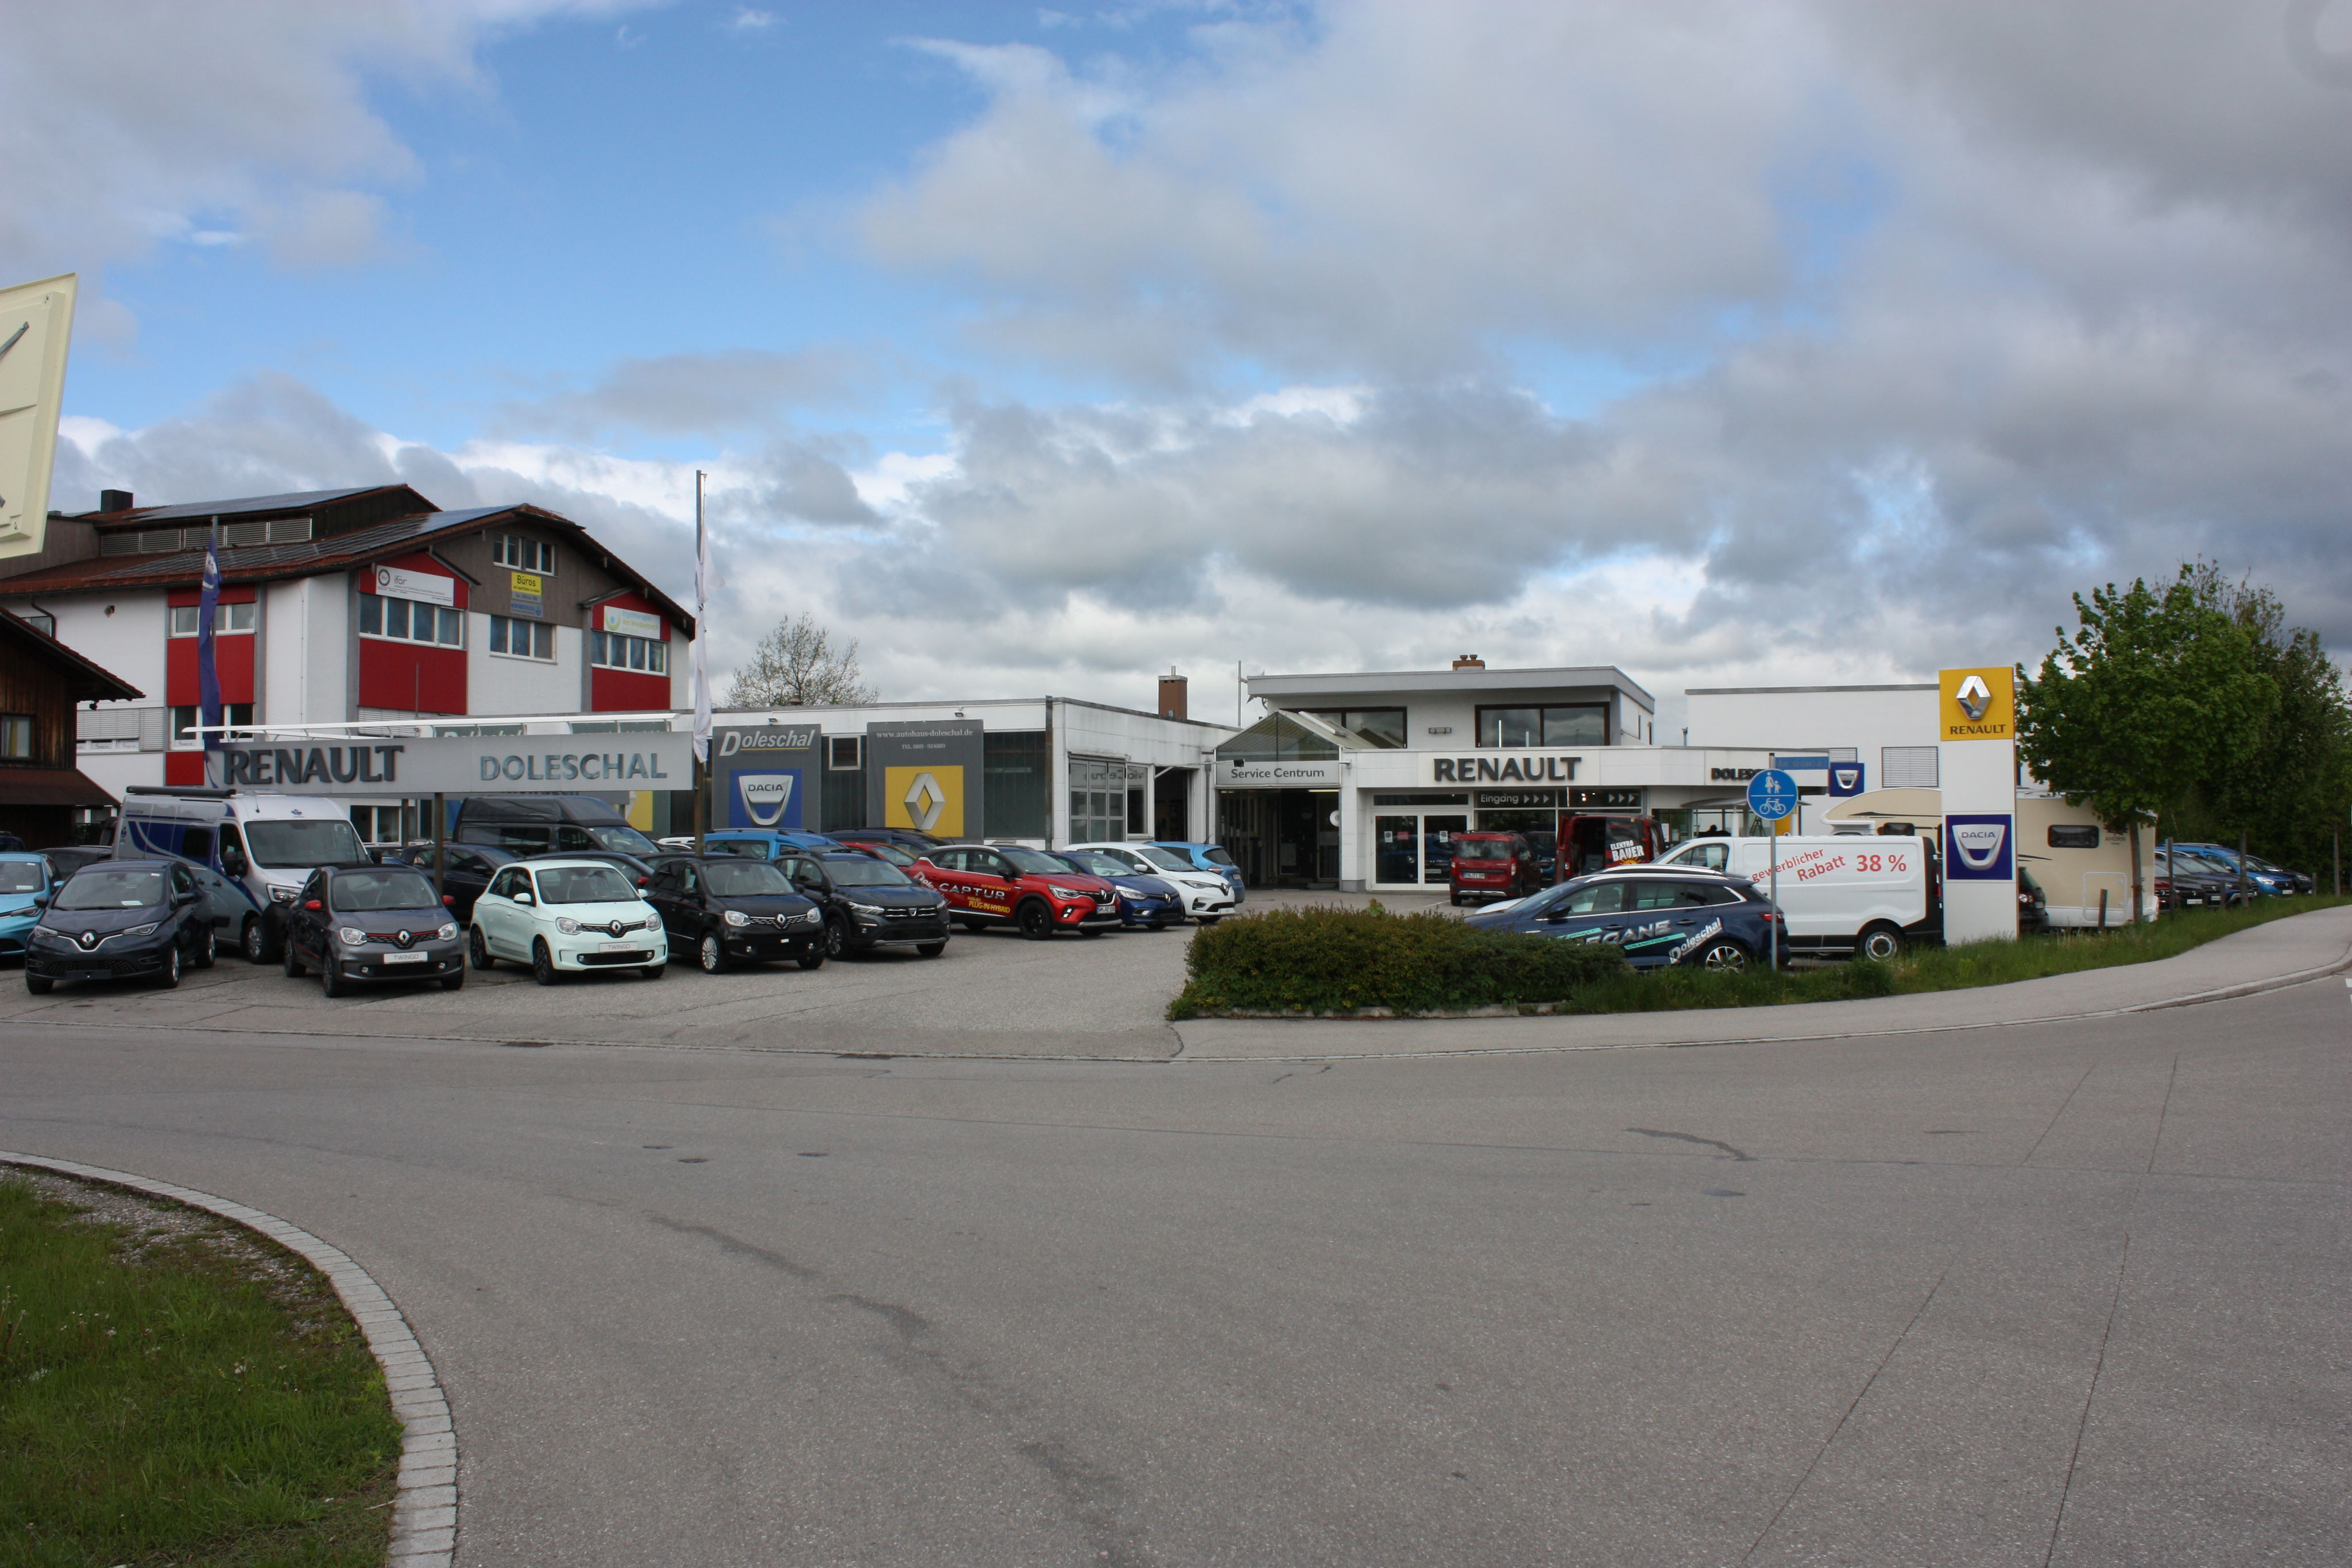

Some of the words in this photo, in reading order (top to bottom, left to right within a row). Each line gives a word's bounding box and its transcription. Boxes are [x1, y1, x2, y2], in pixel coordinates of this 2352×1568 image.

[394, 575, 407, 585] ifor
[517, 575, 536, 586] Büros
[876, 729, 973, 737] www.autohaus-doleschal.de
[1950, 725, 2006, 734] RENAULT
[719, 729, 815, 756] Doleschal
[223, 745, 404, 784] RENAULT
[480, 753, 668, 781] DOLESCHAL
[1434, 757, 1581, 781] RENAULT
[1231, 769, 1271, 778] Service
[1274, 768, 1324, 777] Centrum
[1481, 794, 1518, 803] Eingang
[1610, 840, 1634, 850] ELEKTRO
[1611, 845, 1645, 861] BAUER
[1752, 849, 1824, 883] gewerblicher
[1797, 855, 1846, 881] Rabatt
[1856, 855, 1881, 872] 38
[1889, 854, 1906, 872] %
[939, 883, 1005, 900] CAPTUR
[969, 901, 1010, 913] PLUG-IN-HYBRID
[1627, 937, 1669, 948] GRANDTOUR
[1669, 917, 1721, 964] Doleschal
